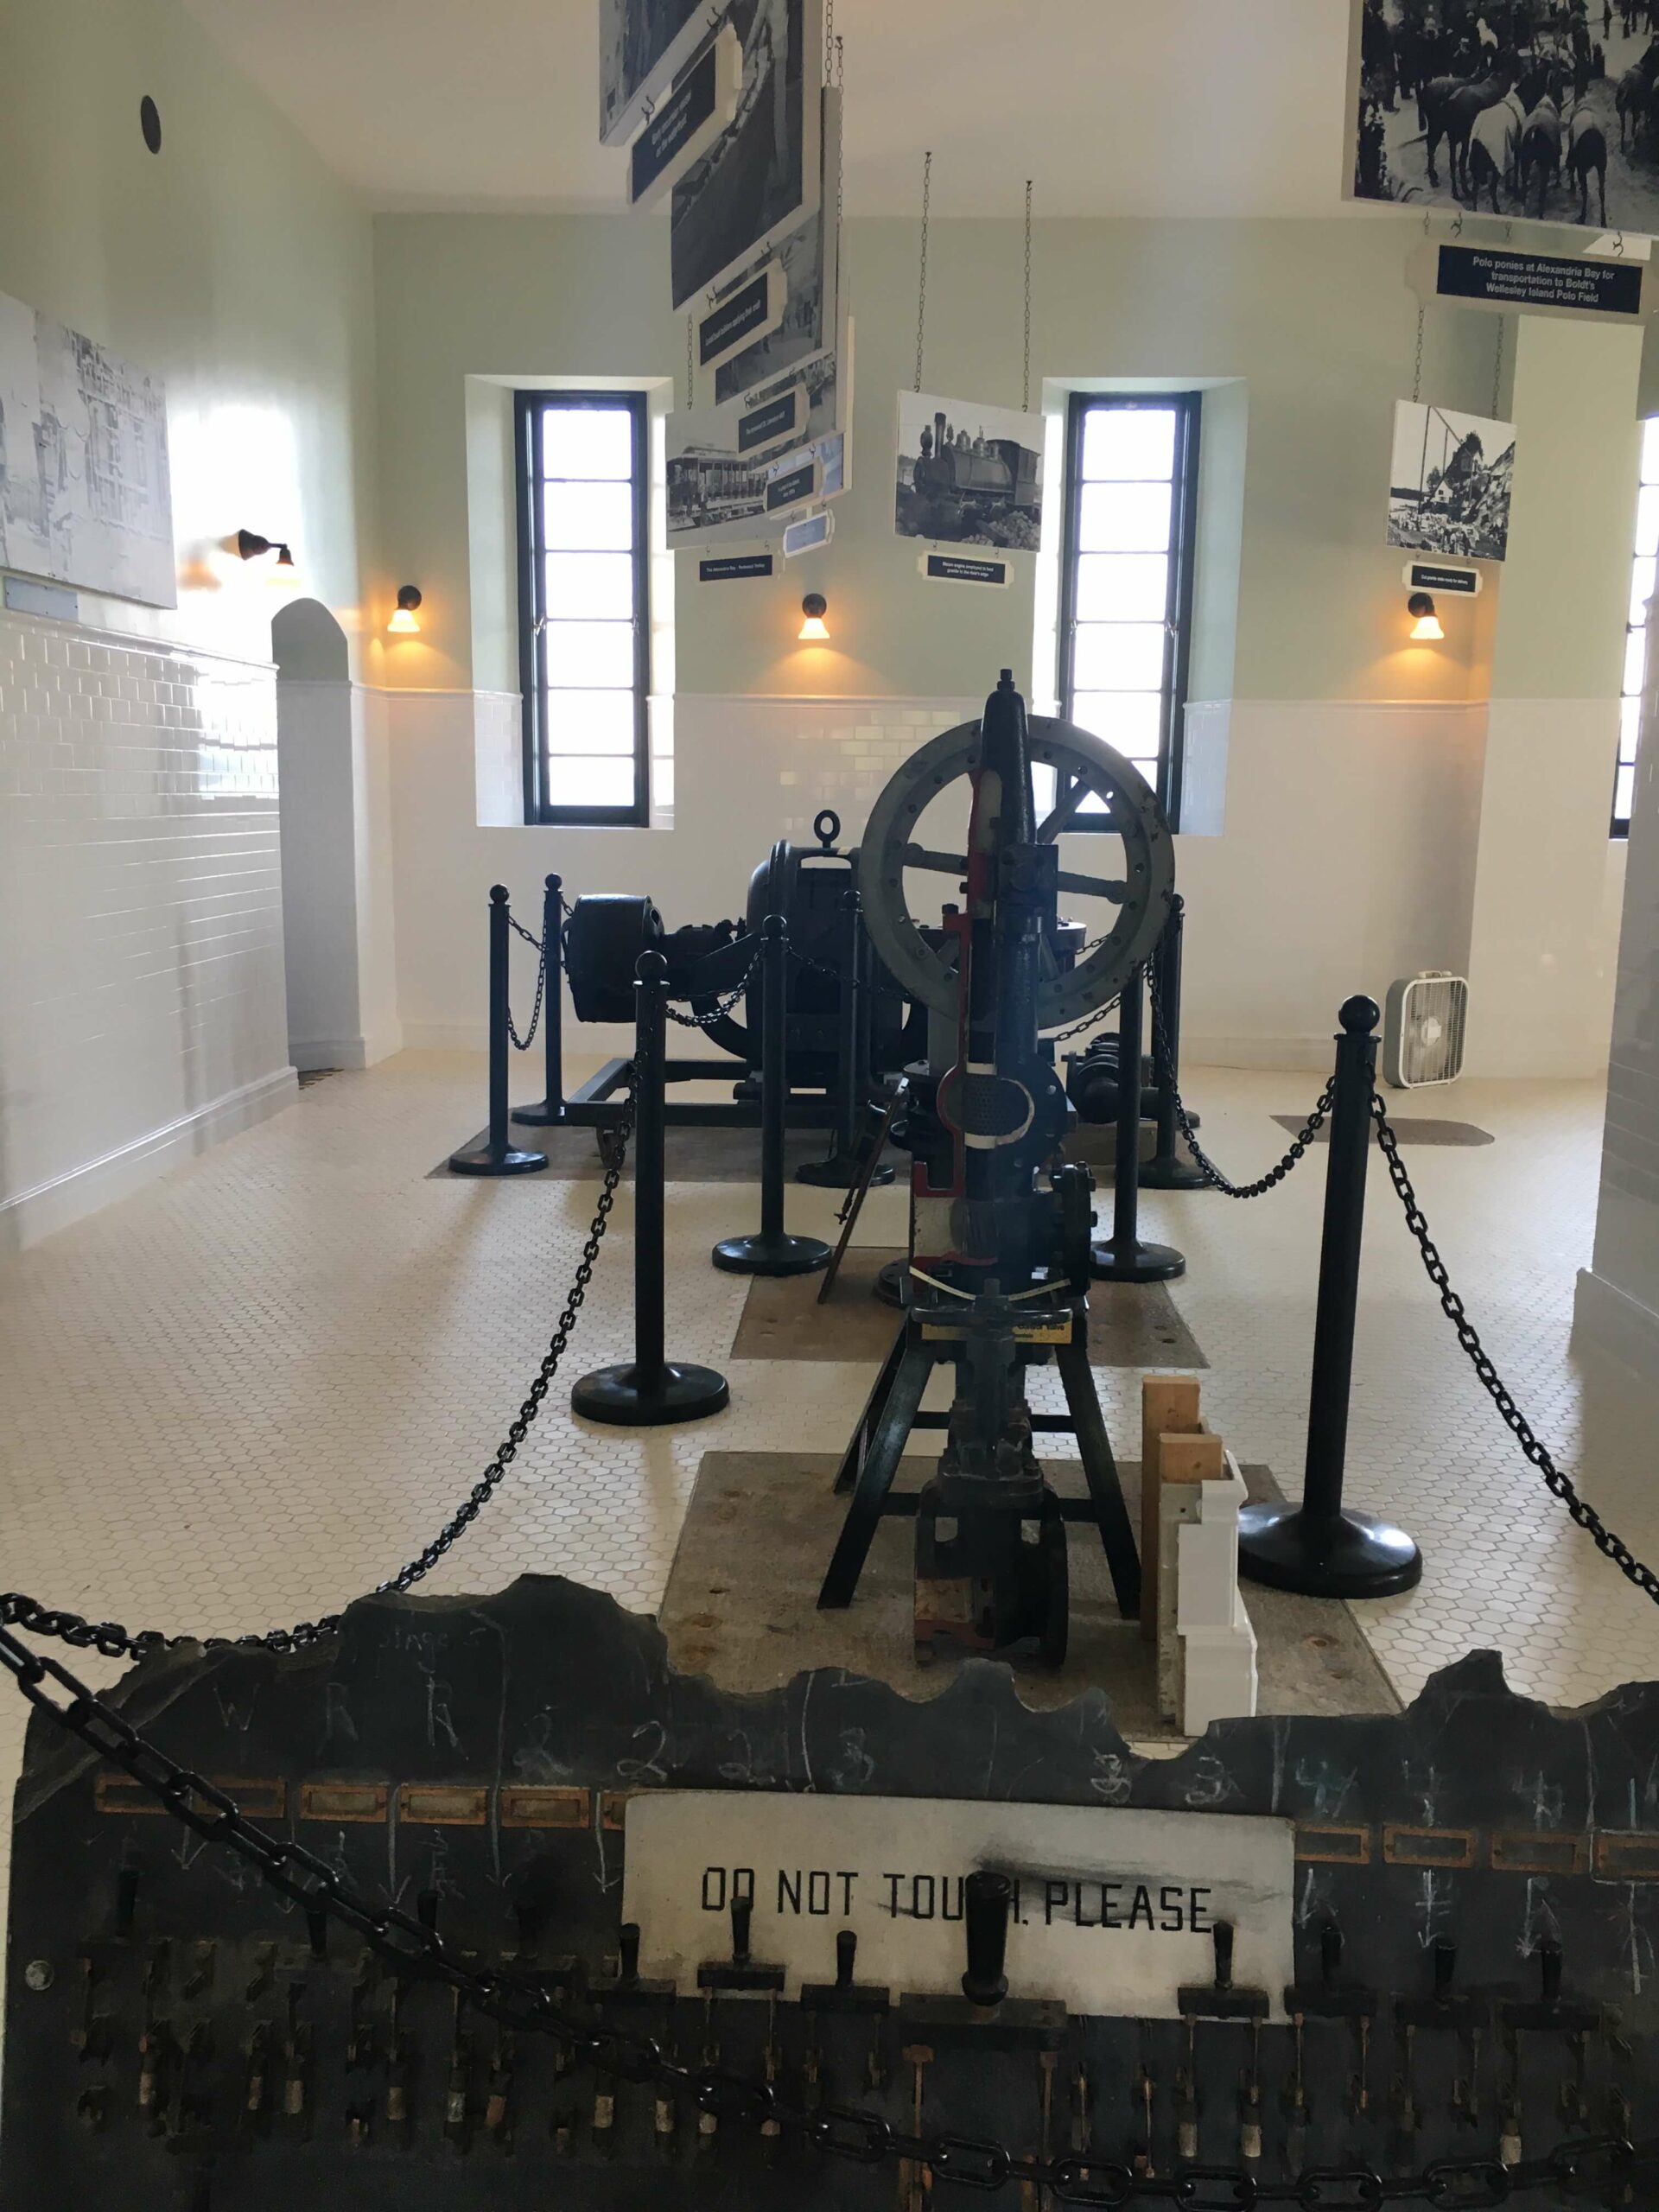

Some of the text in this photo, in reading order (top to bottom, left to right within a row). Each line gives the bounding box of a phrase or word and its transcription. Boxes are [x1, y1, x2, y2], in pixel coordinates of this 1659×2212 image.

[1473, 256, 1615, 280] Polo ponies at Alexandria Bay for
[1486, 283, 1599, 302] Wellesley Island Polo Field
[1491, 271, 1595, 290] transportation to Boldt's
[616, 1719, 670, 1783] 2
[702, 1867, 754, 1911] DO
[778, 1870, 859, 1916] NOT
[1045, 1879, 1212, 1934] PLEASE
